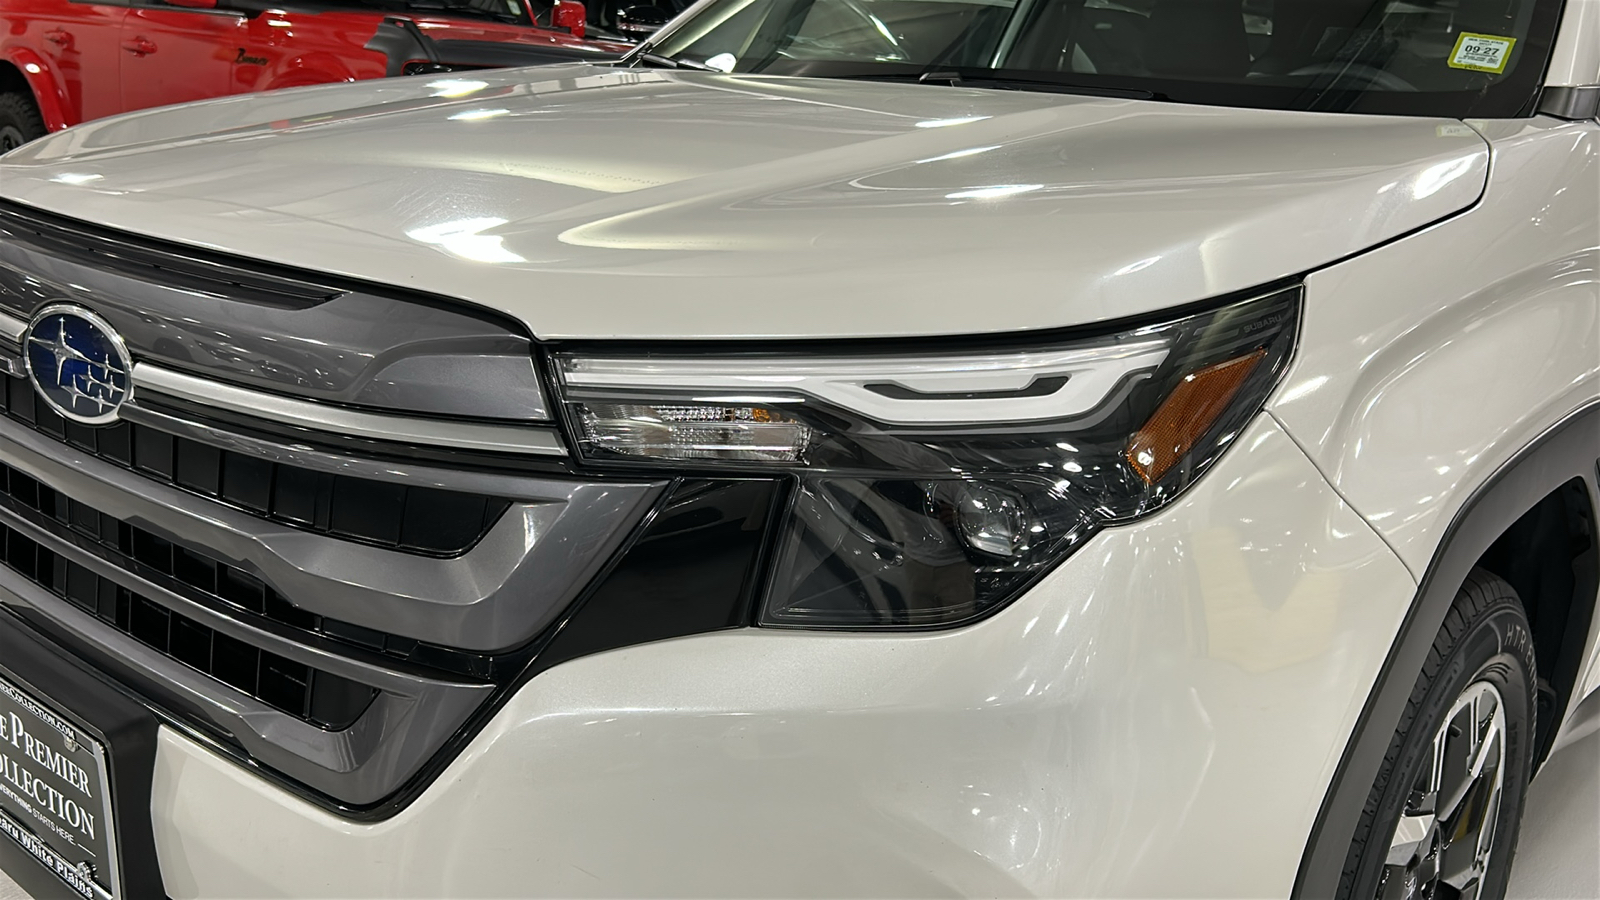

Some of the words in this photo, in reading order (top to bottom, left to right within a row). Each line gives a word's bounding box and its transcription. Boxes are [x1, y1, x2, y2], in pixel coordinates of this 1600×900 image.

[1465, 44, 1481, 54] 09
[1483, 47, 1500, 56] 27
[1243, 314, 1282, 334] SUBARU
[1504, 623, 1527, 653] HTR
[9, 711, 93, 798] PREMIER
[32, 808, 56, 832] STARTS
[21, 831, 54, 867] White
[57, 861, 93, 898] Plains
